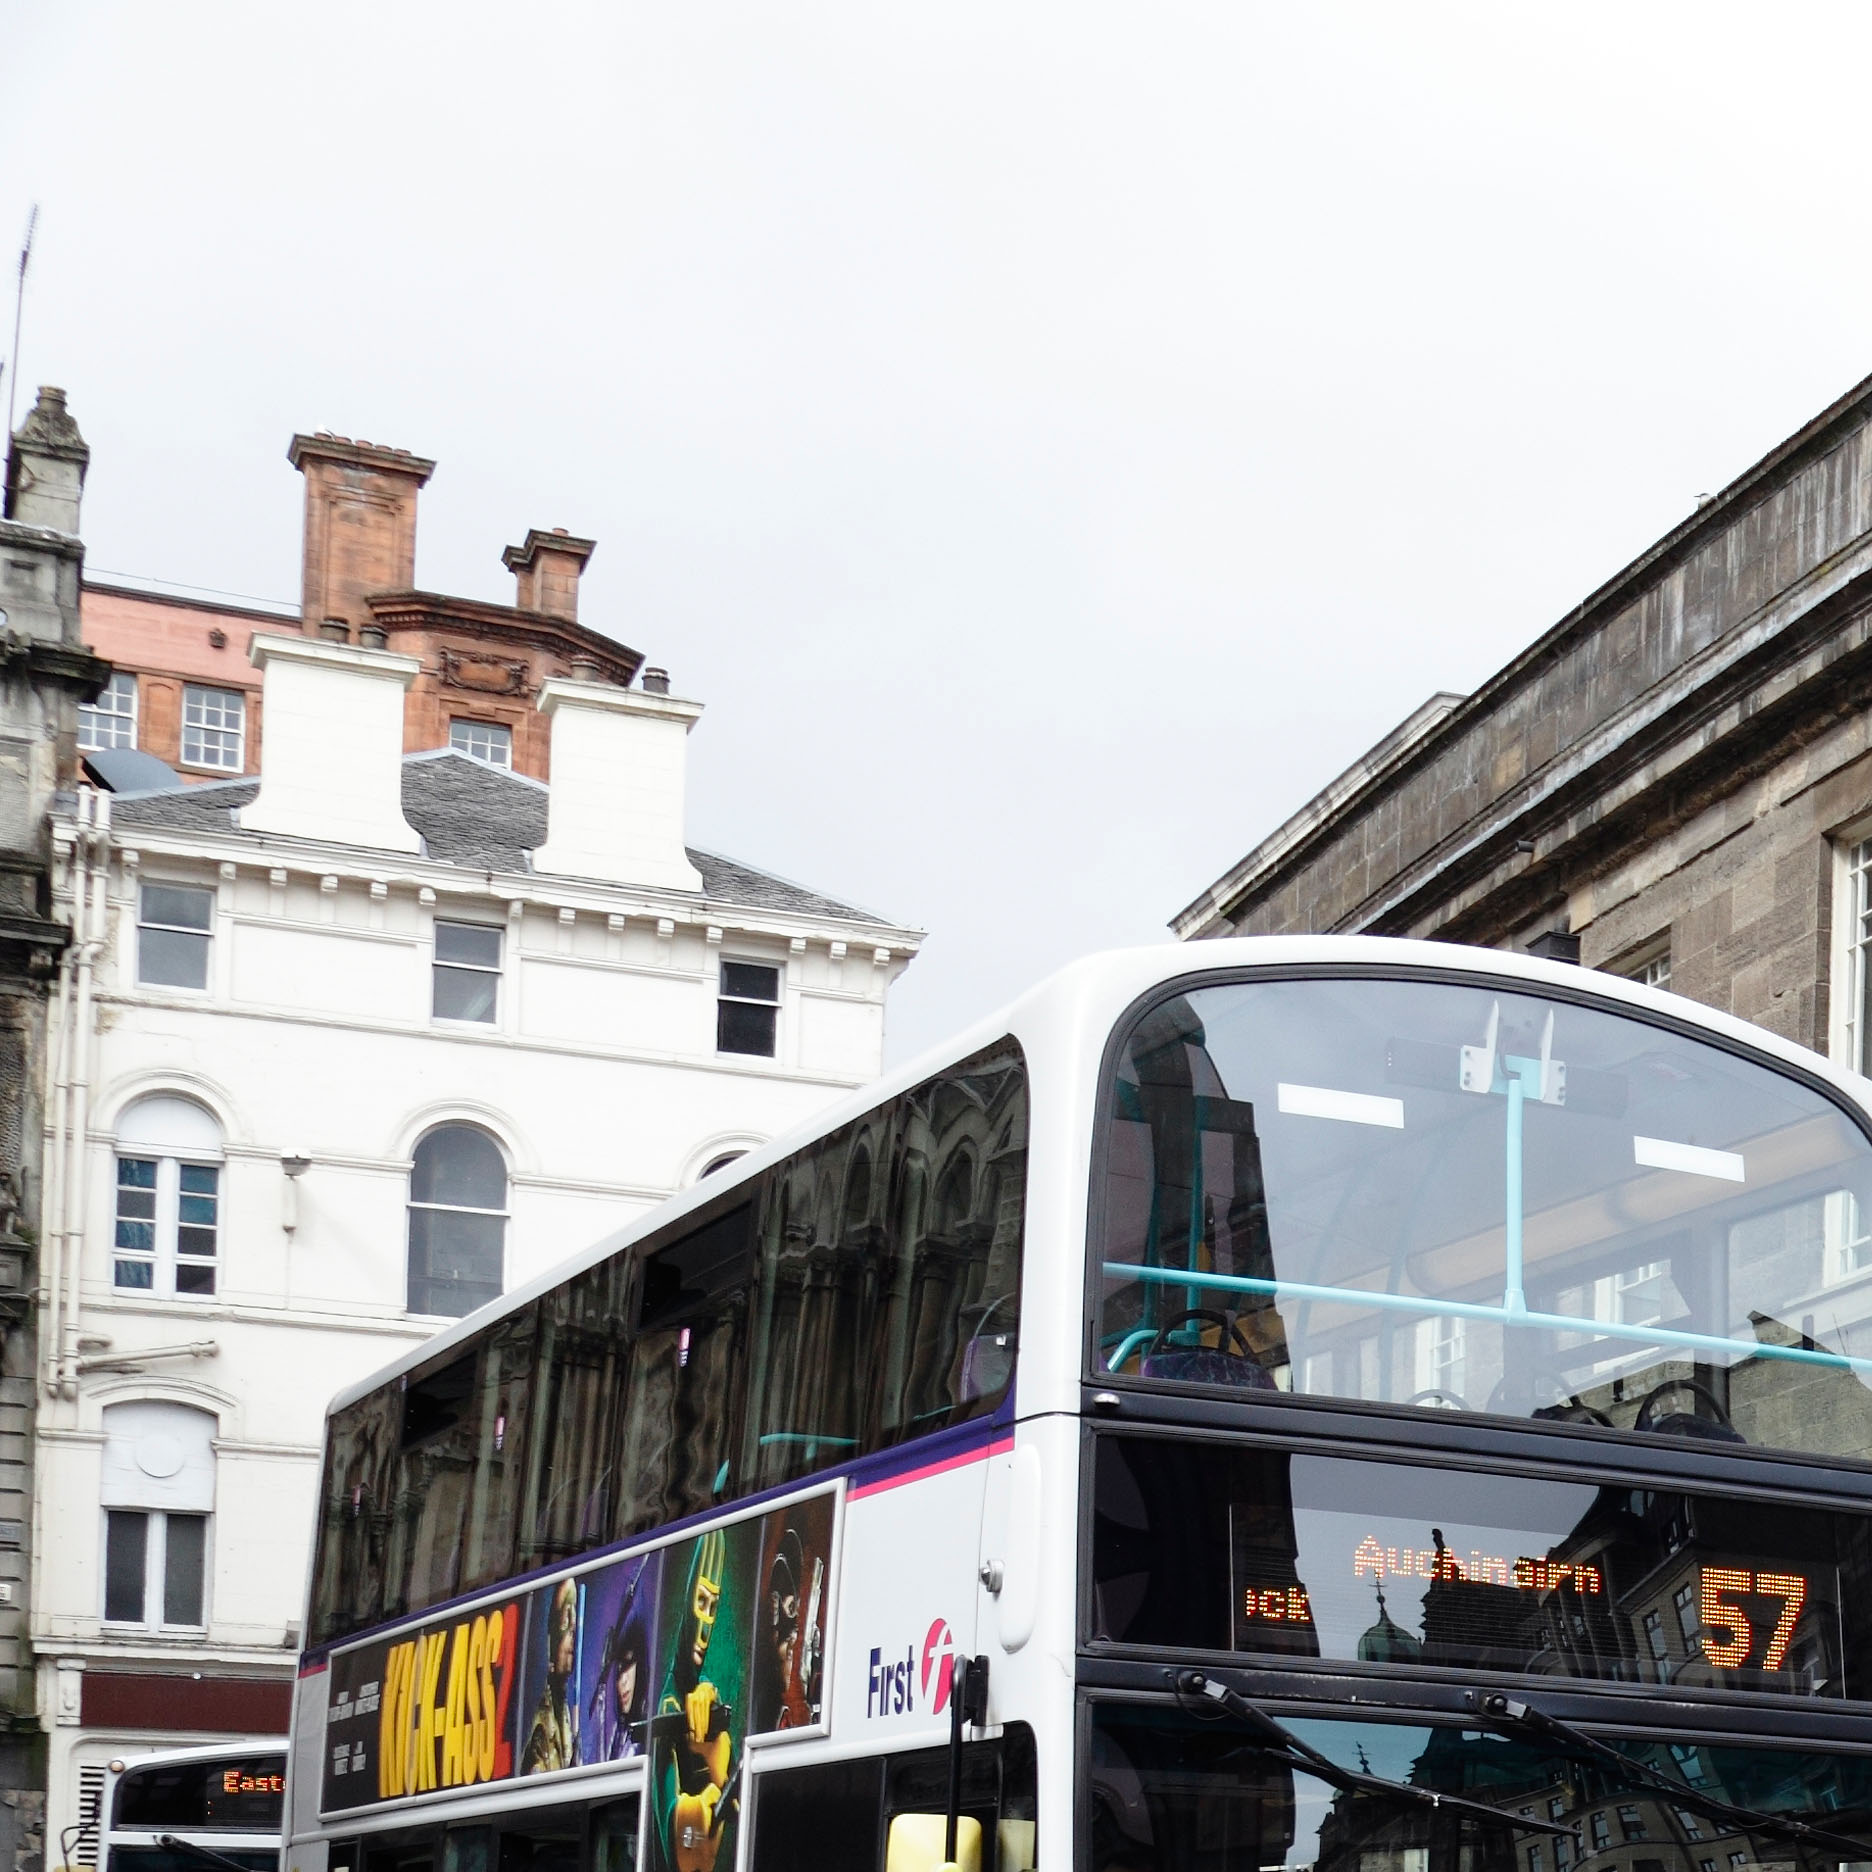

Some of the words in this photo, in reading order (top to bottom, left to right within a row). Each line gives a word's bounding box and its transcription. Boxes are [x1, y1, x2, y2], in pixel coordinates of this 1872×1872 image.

[1354, 1534, 1599, 1593] Auchinairn
[1701, 1568, 1804, 1670] 57
[867, 1644, 915, 1719] First
